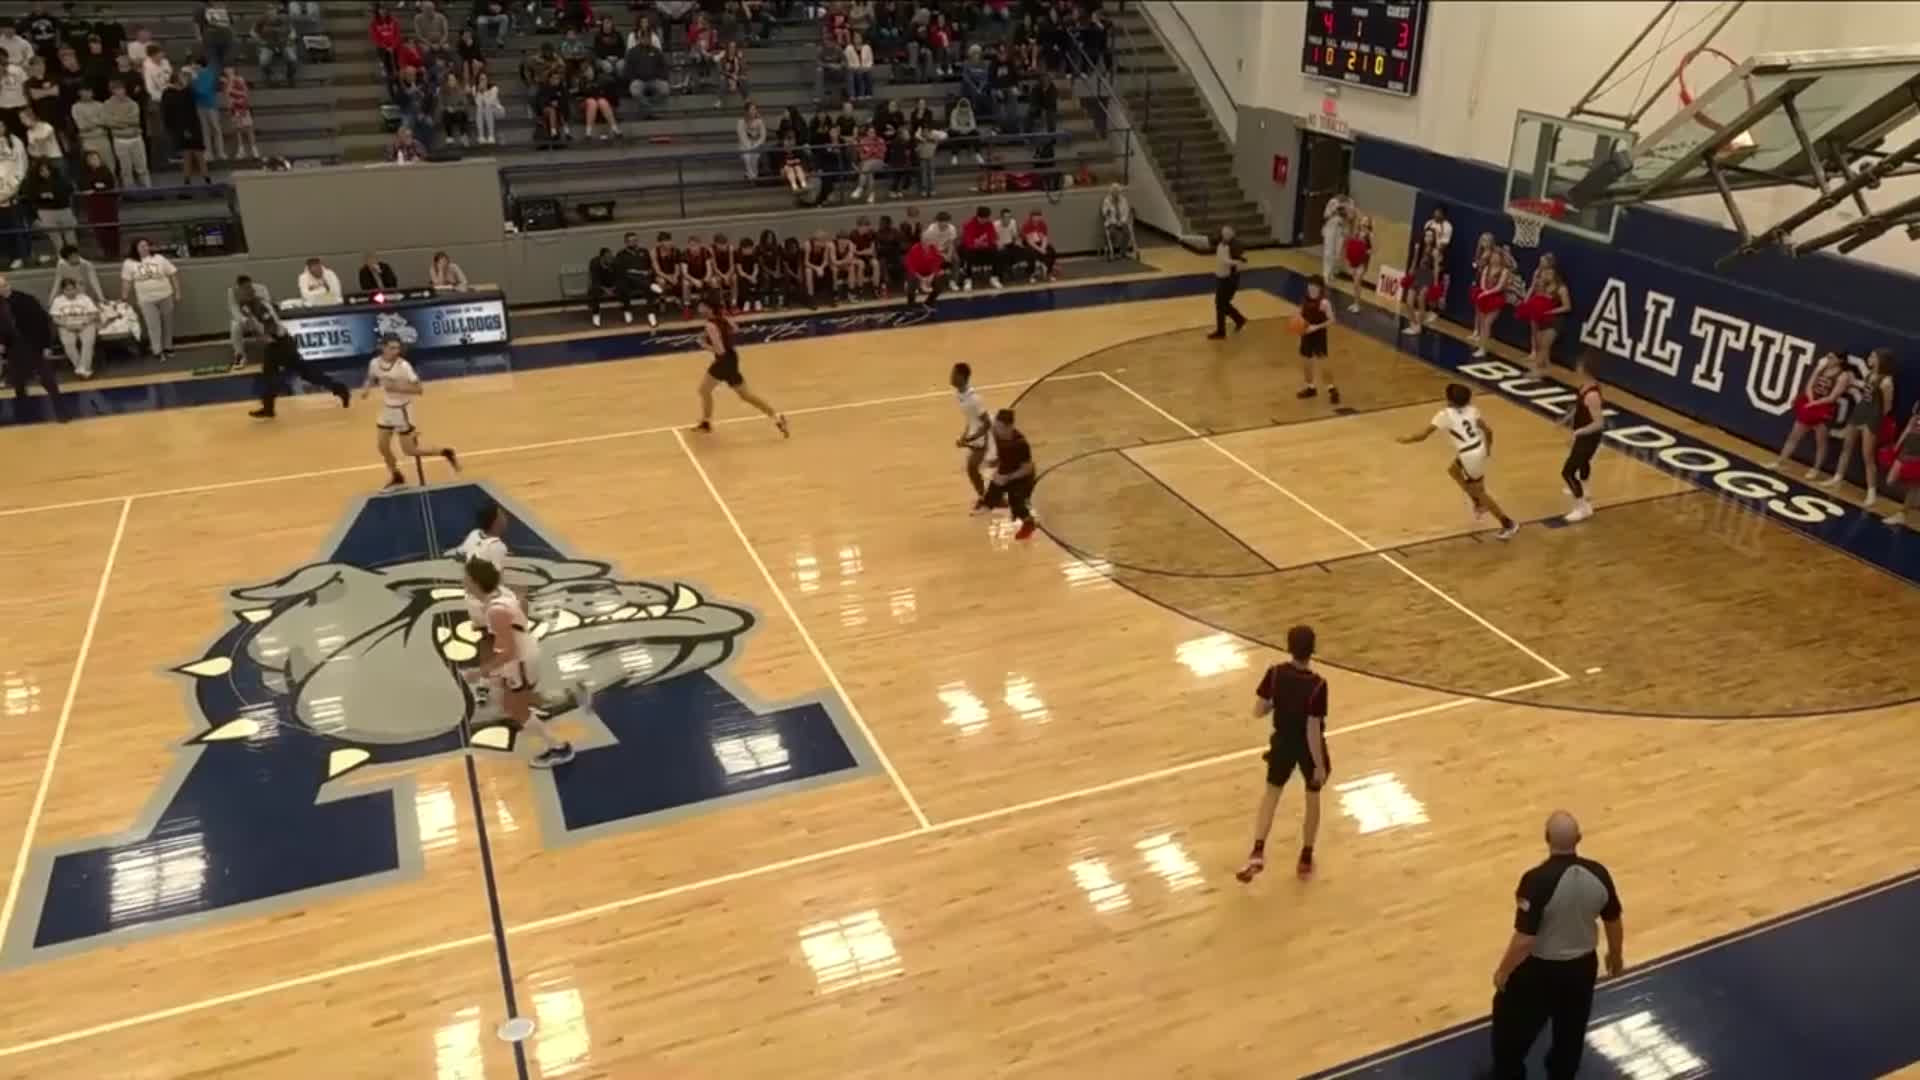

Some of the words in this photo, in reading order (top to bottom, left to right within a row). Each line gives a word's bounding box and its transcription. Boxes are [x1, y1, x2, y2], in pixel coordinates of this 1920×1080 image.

[1323, 13, 1335, 34] 4
[1396, 22, 1410, 49] 3
[1374, 55, 1385, 76] 0
[432, 313, 502, 336] BULLDOGS
[295, 329, 352, 349] ALTUS
[1462, 419, 1477, 438] 2
[1457, 358, 1846, 524] BULDOGS
